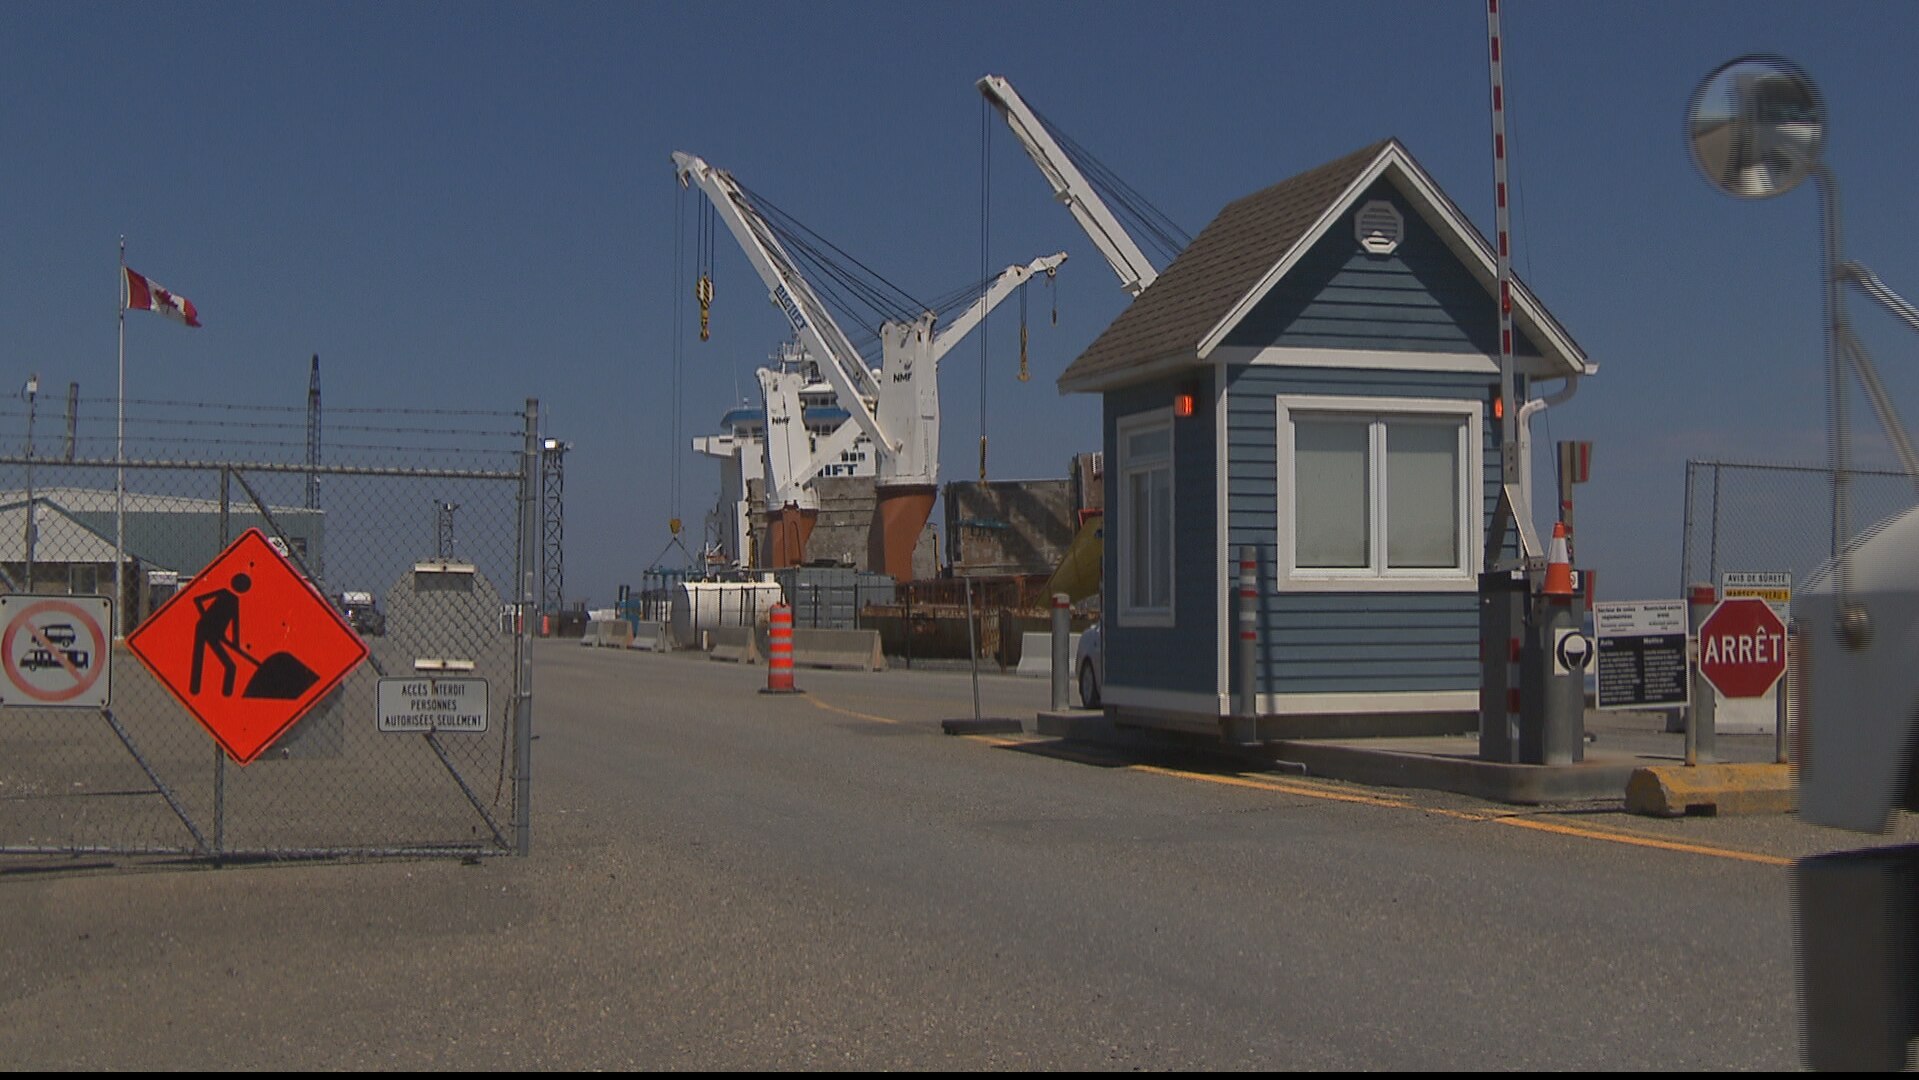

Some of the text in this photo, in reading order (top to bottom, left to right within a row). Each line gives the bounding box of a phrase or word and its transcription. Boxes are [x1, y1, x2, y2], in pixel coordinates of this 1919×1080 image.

[893, 372, 913, 383] NMF
[772, 415, 791, 425] NMF
[1704, 625, 1781, 664] ARRÊT
[432, 684, 465, 696] INTERDIT
[410, 700, 457, 711] PERSONNES
[385, 714, 481, 727] AUTORISÉES SEULEMENT
